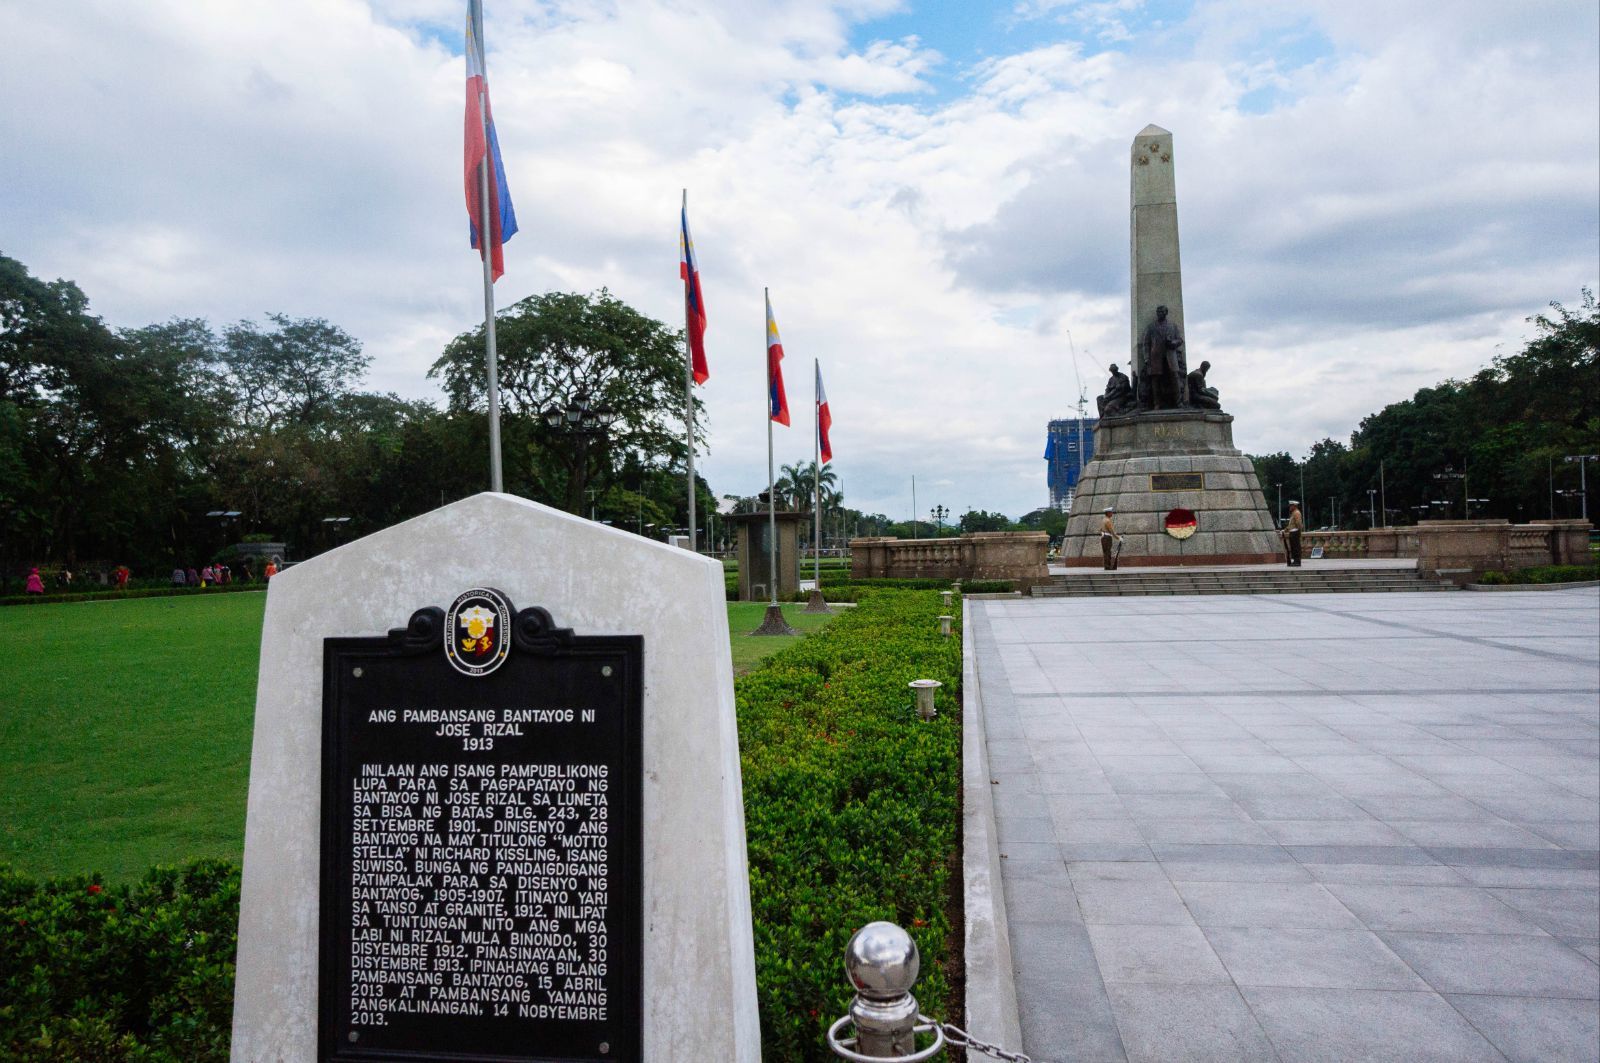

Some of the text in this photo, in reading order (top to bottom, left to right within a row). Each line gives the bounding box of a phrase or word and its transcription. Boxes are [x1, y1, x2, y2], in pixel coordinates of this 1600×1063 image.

[457, 591, 493, 604] HISTORICAL
[369, 710, 595, 722] ANG PAMBANSANG BANTAYOG NI
[436, 724, 523, 736] JOSE RIZAL
[463, 738, 493, 750] 1913
[362, 765, 608, 778] INILAAN ANG ISANG PAMPUBLIKONG
[354, 779, 608, 793] LUPA PARA SA PAGPAPATAYO NG
[354, 793, 608, 807] BANTAYOG NI JOSE RIZAL SA LUNETA
[354, 807, 607, 821] SA BISA NG BATAS BLG. 243, 28
[354, 820, 607, 835] SETYEMBRE 1901. DINISENYO ANG
[353, 834, 607, 849] BANTAYOG NA MAY TITULONG “MOTTO
[353, 847, 607, 863] STELLA” NI RICHARD KISSLING, ISANG
[353, 860, 607, 877] SUWISO, BUNGA NG PANDAIGDIGANG
[353, 874, 607, 891] PATIMPALAK PARA SA DISENYO NG
[353, 888, 607, 906] BANTAYOG, 1905-1907. ITINAYO YARI
[353, 902, 607, 921] SA TANSO AT GRANITE, 1912. INILIPAT
[353, 916, 607, 935] SA TUNTUNGAN NITO ANG MGA
[352, 930, 607, 950] LABI NI RIZAL MULA BINONDO, 30
[352, 943, 606, 963] DISYEMBRE 1912. PINASINAYAAN, 30
[352, 957, 607, 978] DISYEMBRE 1913. IPINAHAYAG BILANG
[352, 970, 606, 992] PAMBANSANG BANTAYOG, 15 ABRIL
[352, 984, 606, 1006] 2013 AT PAMBANSANG YAMANG
[352, 998, 606, 1020] PANGKALINANGAN, 14 NOBYEMBRE
[352, 1012, 388, 1026] 2013.
